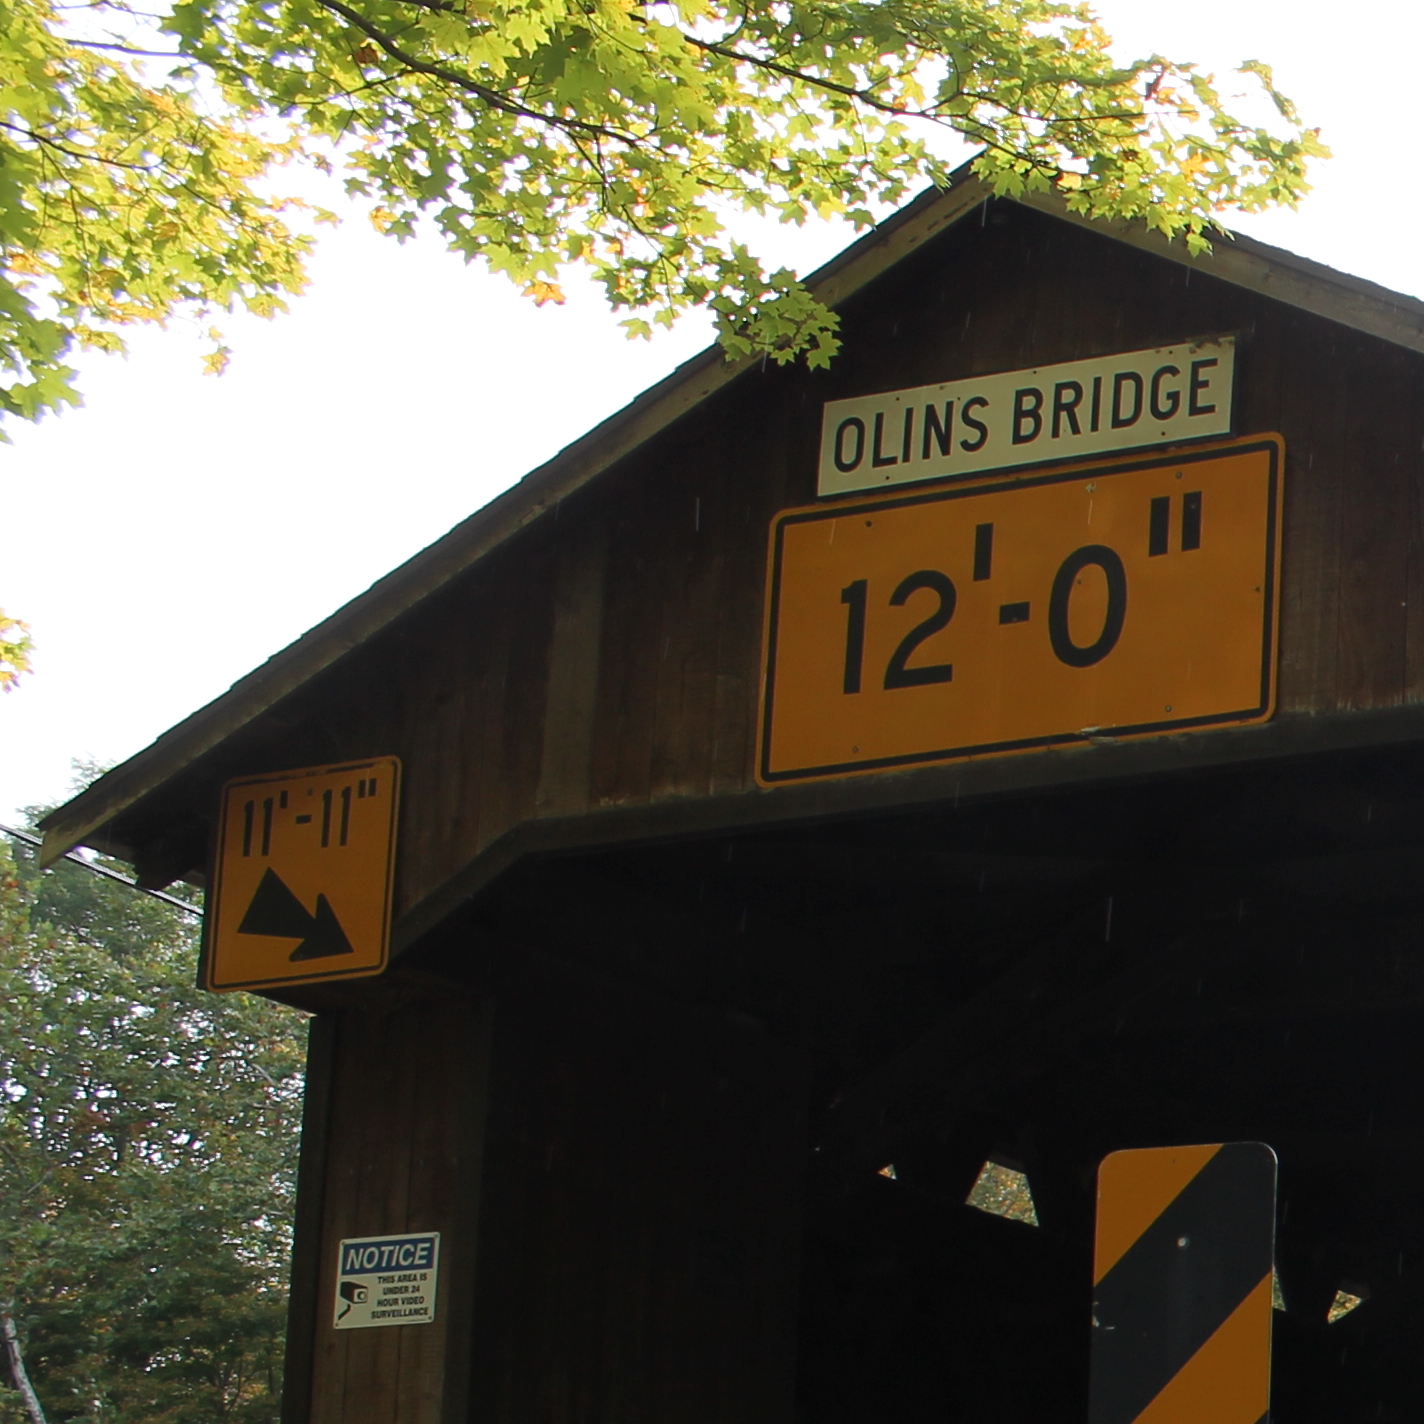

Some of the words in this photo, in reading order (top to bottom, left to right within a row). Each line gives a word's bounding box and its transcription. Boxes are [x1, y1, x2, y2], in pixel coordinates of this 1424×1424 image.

[833, 396, 989, 473] OLINS
[1011, 358, 1219, 445] BRIDGE
[345, 1242, 431, 1270] NOTICE
[377, 1275, 395, 1284] THIS
[397, 1273, 418, 1282] AREA
[420, 1272, 427, 1281] IS
[383, 1286, 409, 1295] UNDER
[411, 1285, 420, 1293] 24
[377, 1298, 399, 1307] HOUR
[401, 1296, 425, 1305] VIDEO
[371, 1307, 428, 1319] SURVEILLANCE
